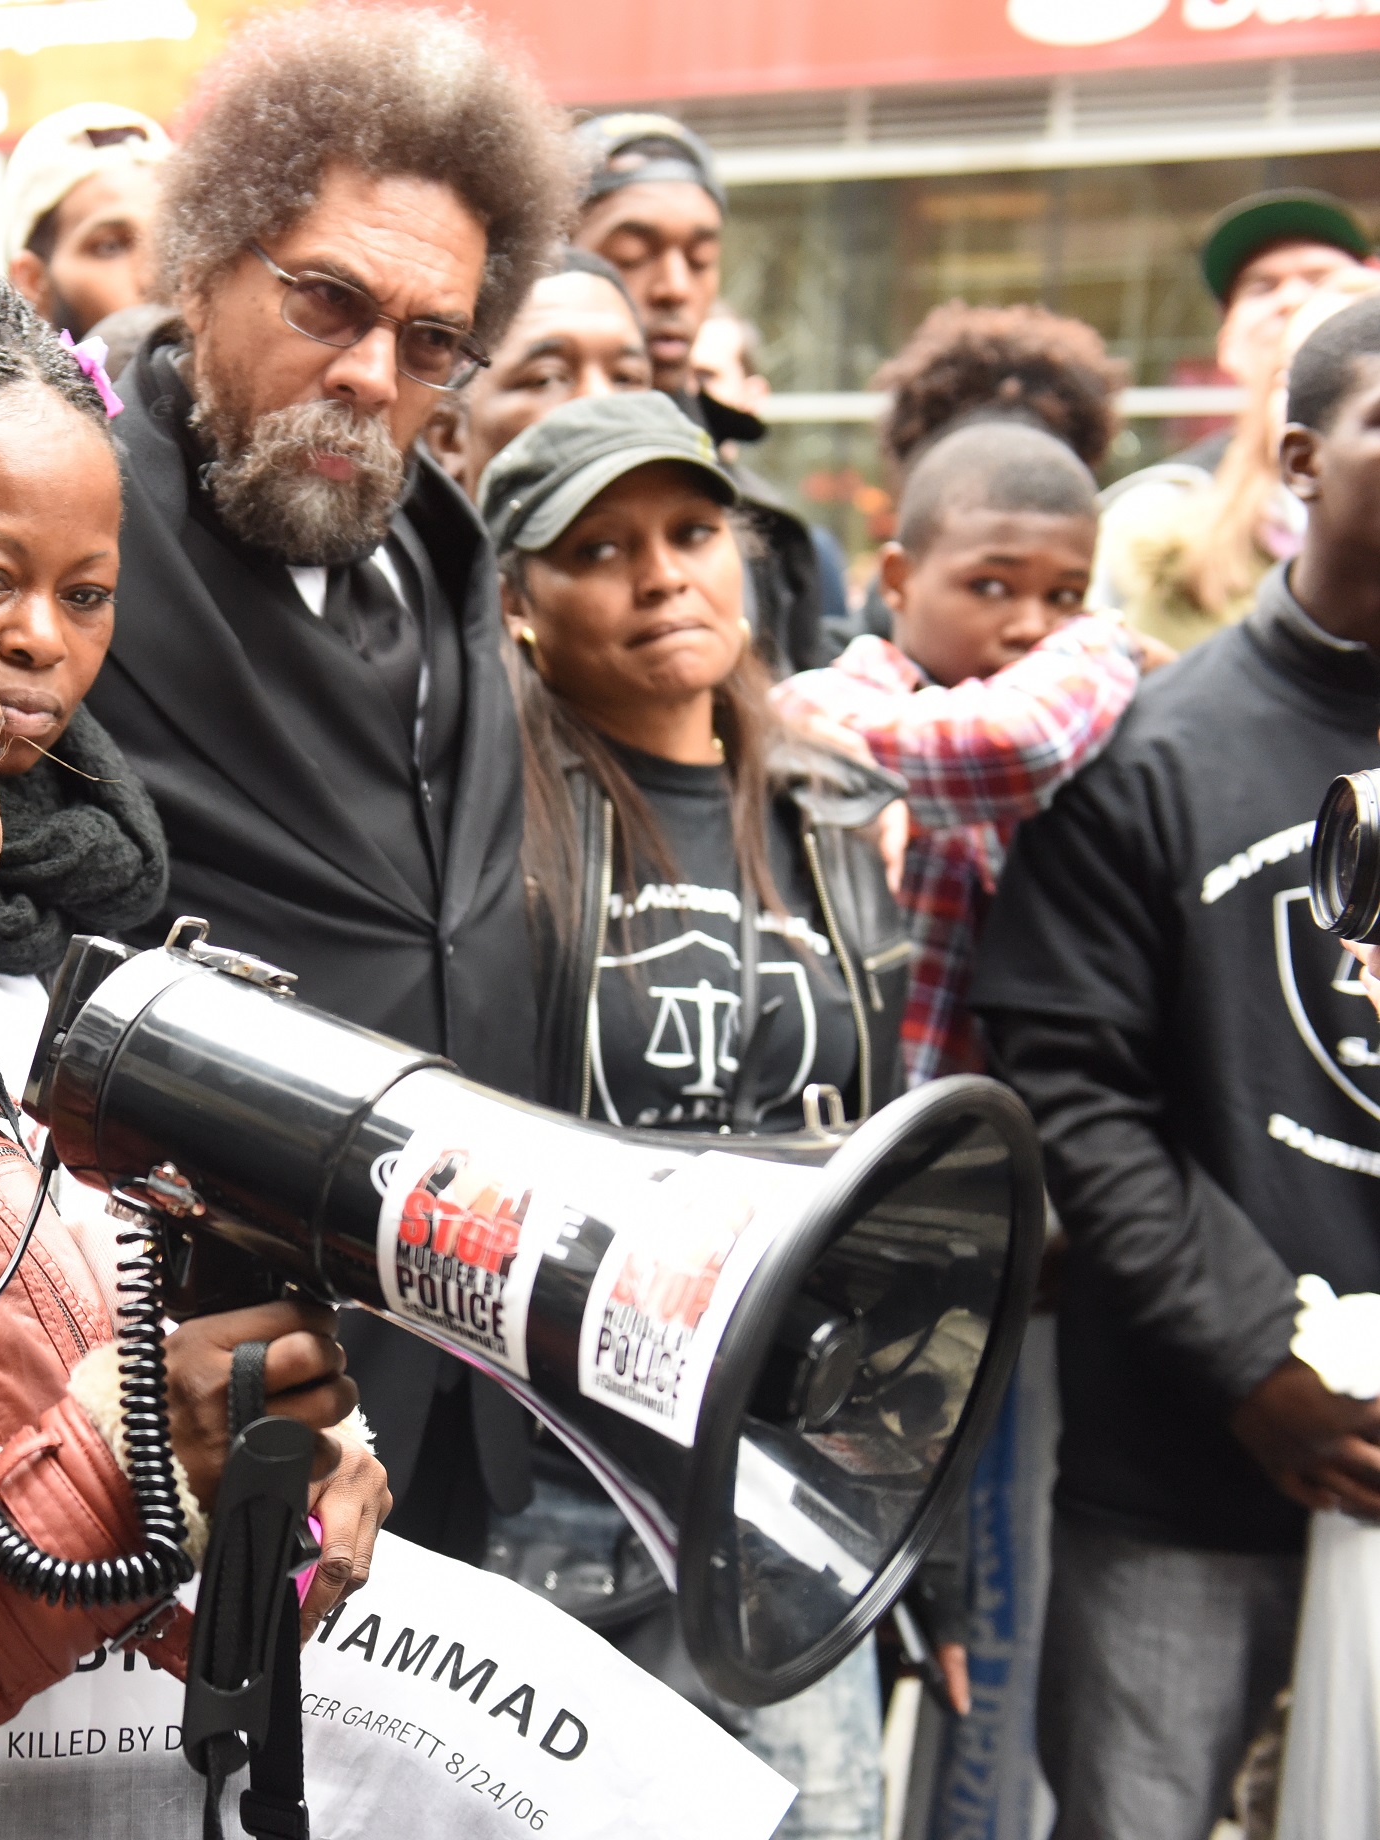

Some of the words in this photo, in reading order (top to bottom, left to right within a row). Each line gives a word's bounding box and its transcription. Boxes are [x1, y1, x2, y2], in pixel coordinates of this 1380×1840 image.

[399, 1187, 521, 1273] STOP
[397, 1265, 504, 1340] POLICE
[596, 1327, 686, 1399] POLICE
[8, 1729, 107, 1759] KILLED
[118, 1726, 155, 1753] BY
[342, 1705, 446, 1759] GARRETT
[445, 1752, 549, 1831] 8/24/06
